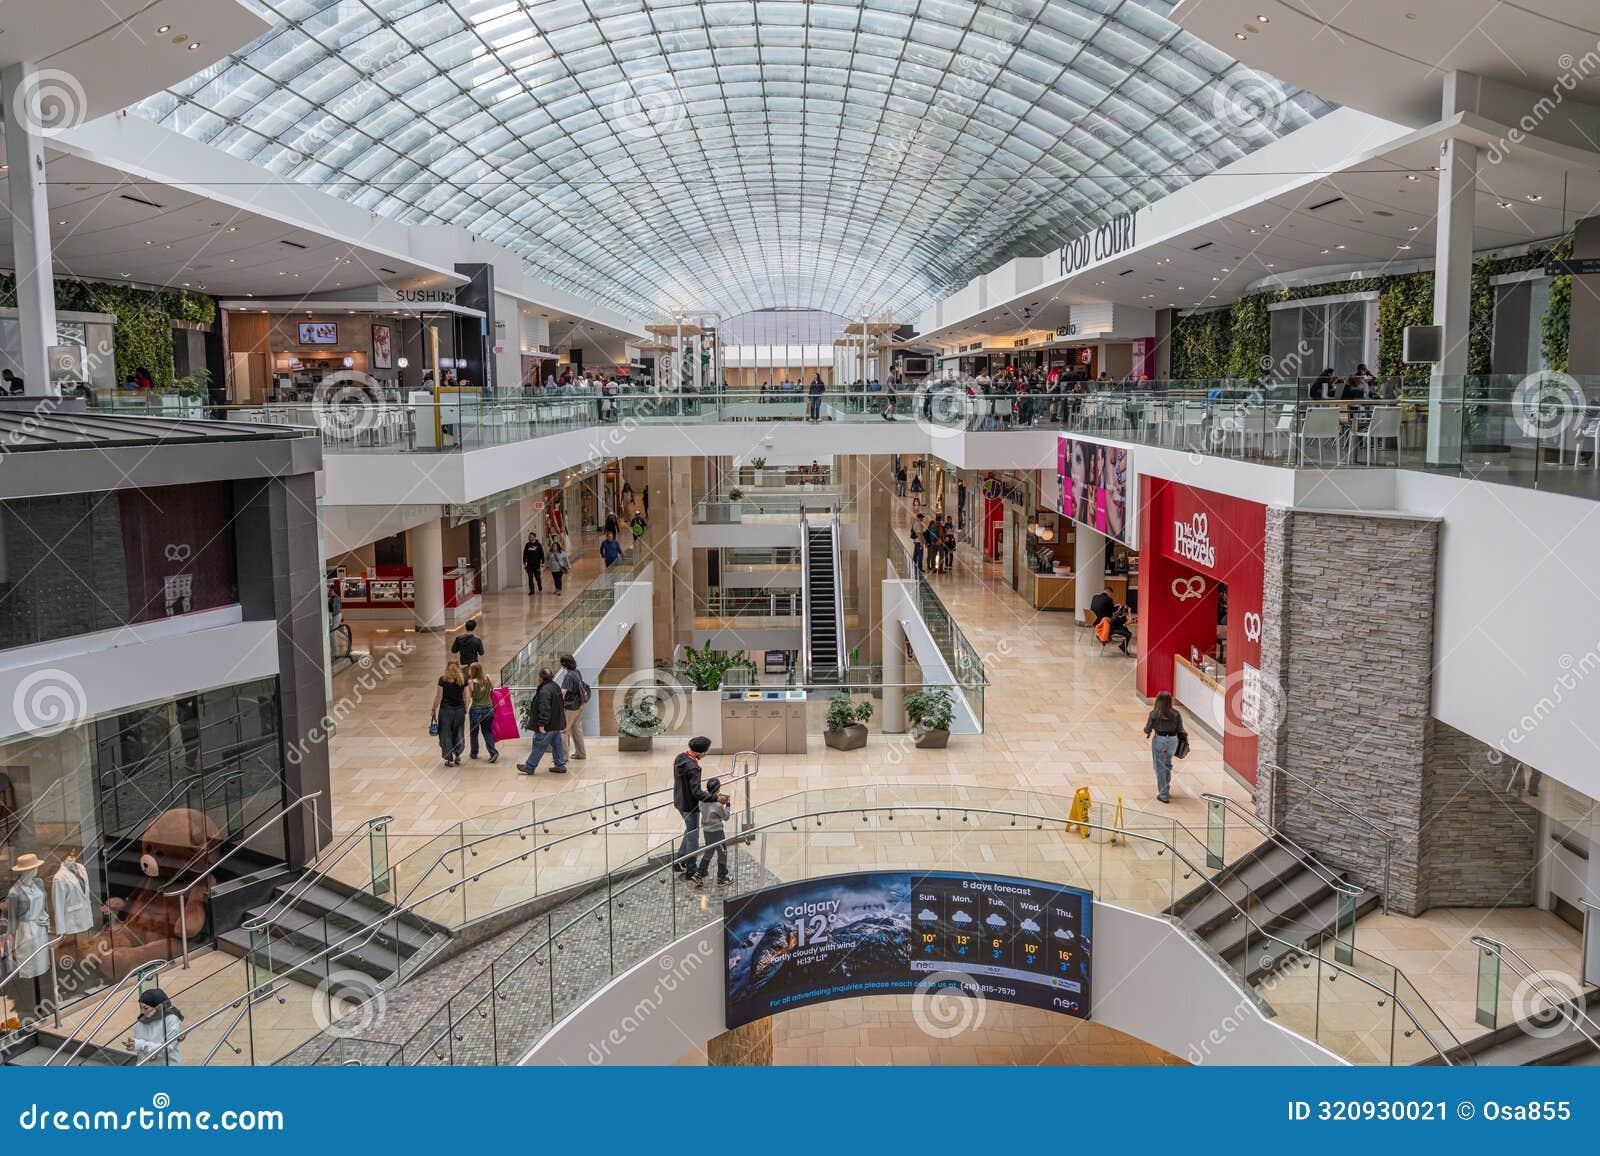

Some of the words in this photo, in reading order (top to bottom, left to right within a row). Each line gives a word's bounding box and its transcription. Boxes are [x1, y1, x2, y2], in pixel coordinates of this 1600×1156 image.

[1060, 233, 1091, 277] FOOD
[1095, 206, 1138, 262] COURT
[397, 289, 440, 302] SUSHI
[1174, 520, 1215, 569] Pretzels
[962, 880, 969, 889] 5
[970, 881, 992, 893] days
[993, 883, 1031, 896] forecast
[784, 899, 840, 918] Calgary
[919, 893, 937, 901] Sun.
[952, 895, 973, 903] Mon.
[988, 897, 1005, 906] Tue.
[1020, 902, 1041, 912] Wed.
[1056, 908, 1074, 918] Thu.
[793, 946, 818, 958] cloudy
[820, 943, 836, 952] with
[837, 940, 856, 949] wind
[782, 995, 791, 1004] all
[792, 987, 832, 1001] advertising
[832, 983, 863, 994] inquiries
[864, 980, 889, 990] please
[890, 979, 913, 988] reach
[947, 981, 957, 989] at
[981, 984, 1016, 996] 815-7570
[1053, 998, 1079, 1011] neo
